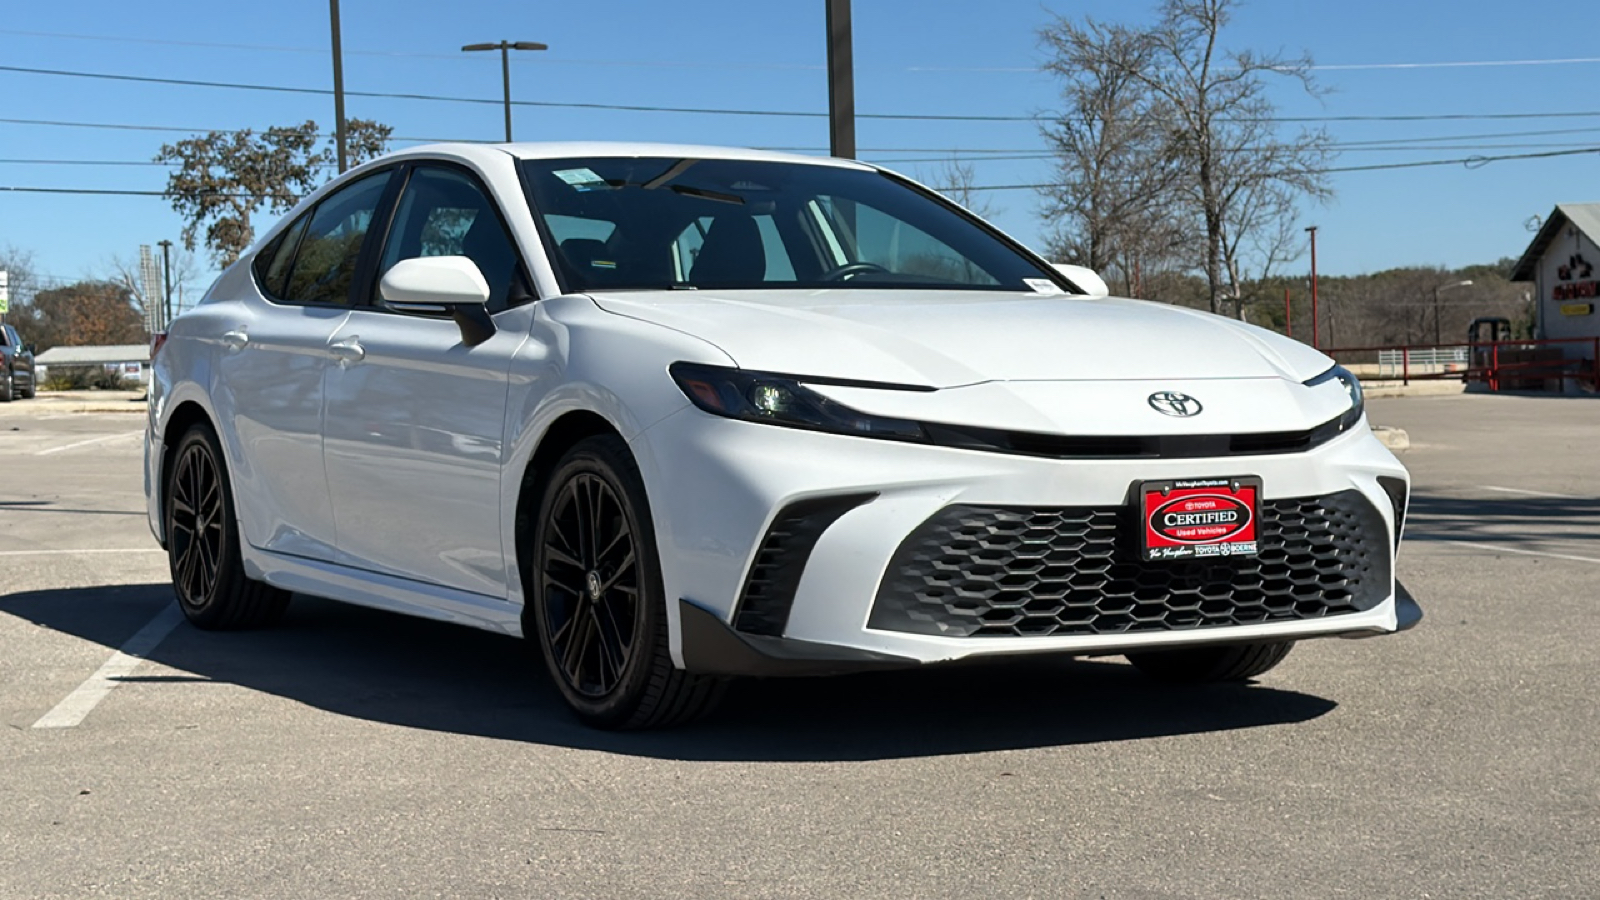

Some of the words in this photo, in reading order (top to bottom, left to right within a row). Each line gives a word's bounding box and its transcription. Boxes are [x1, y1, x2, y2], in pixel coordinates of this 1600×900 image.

[1194, 501, 1216, 510] TOYOTA
[1176, 529, 1196, 537] Used
[1197, 526, 1227, 535] Vehicles
[1195, 546, 1220, 555] TOYOTA
